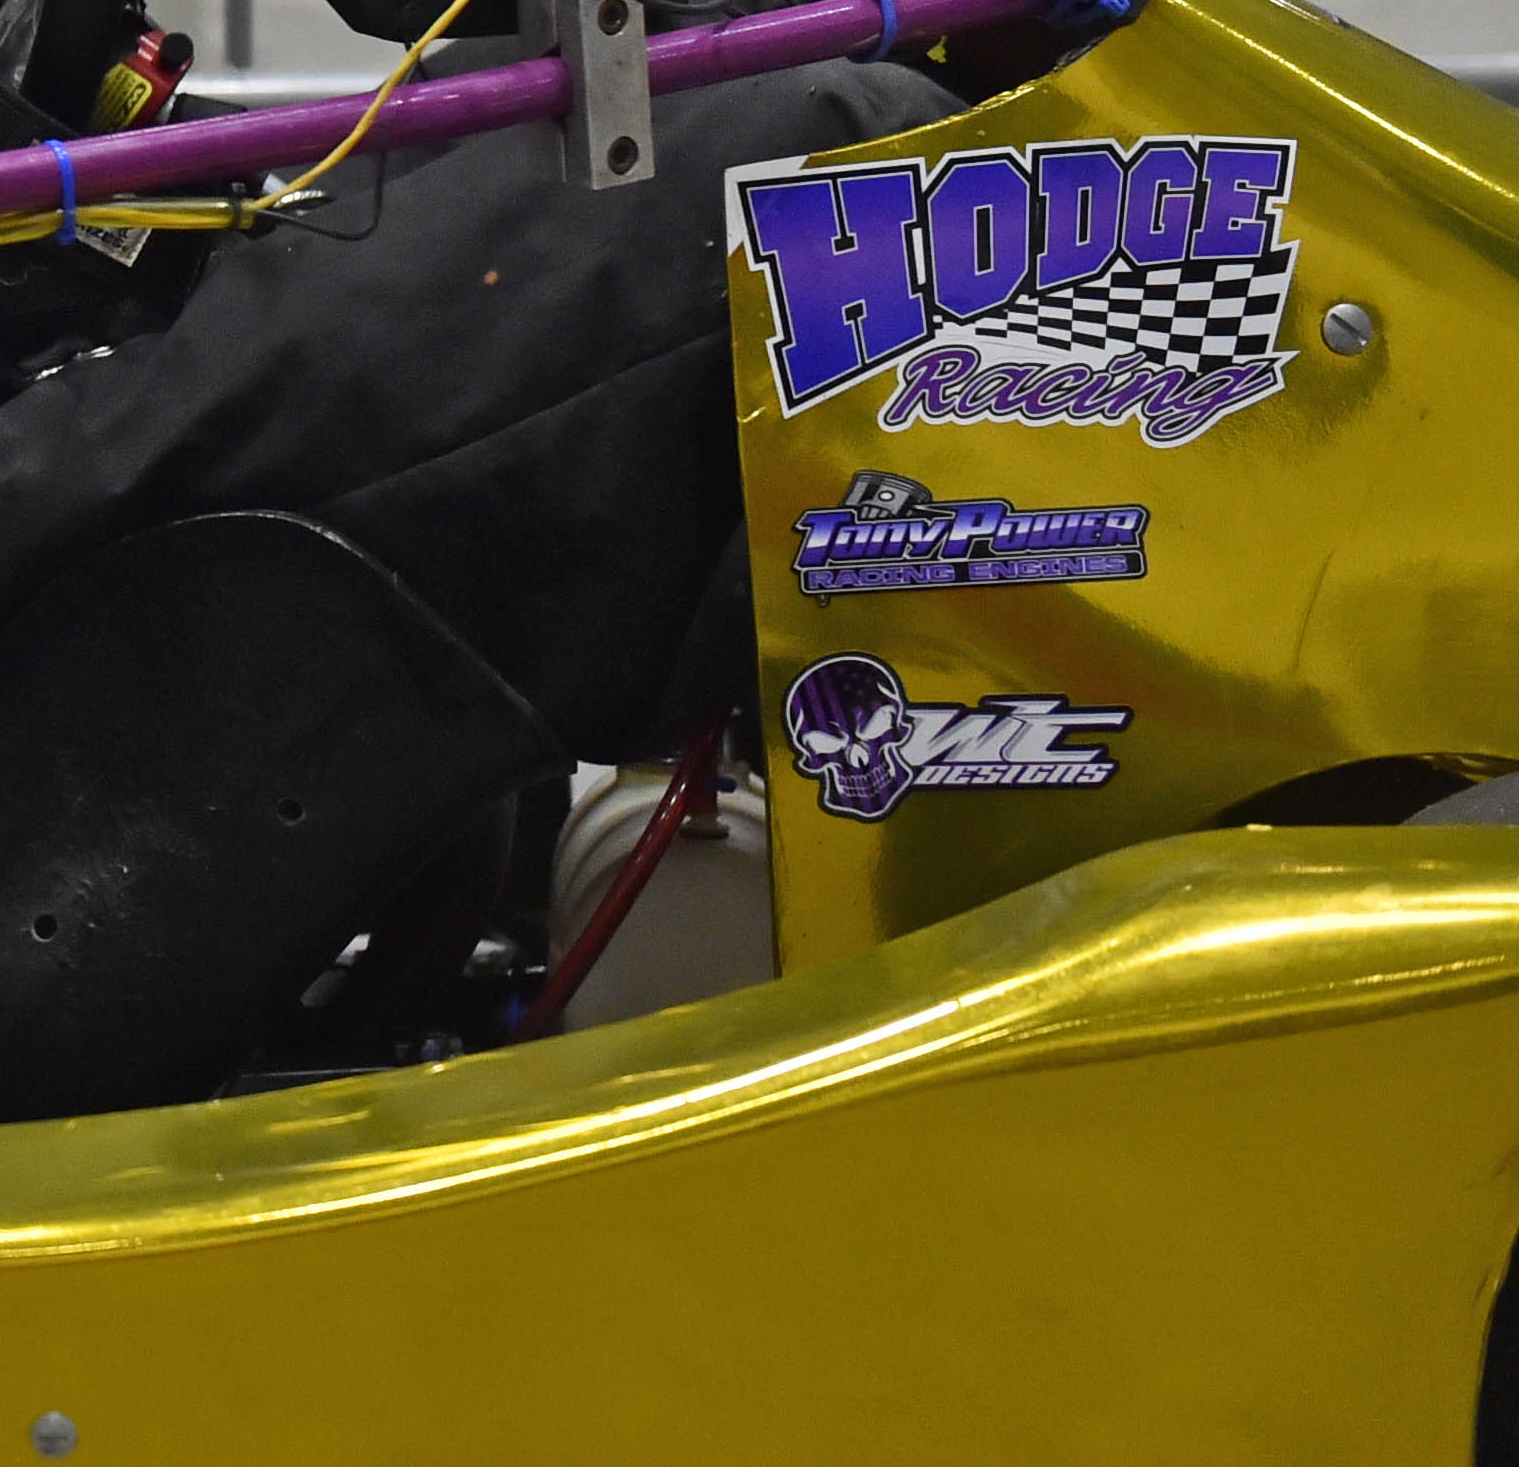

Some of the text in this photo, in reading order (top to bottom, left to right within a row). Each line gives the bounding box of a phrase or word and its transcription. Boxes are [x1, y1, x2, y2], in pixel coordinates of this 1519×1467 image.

[744, 146, 1283, 399] HODGE
[881, 344, 1280, 442] Racing
[808, 554, 1129, 590] RACING ENGINES
[912, 762, 1115, 785] DESIGNS
